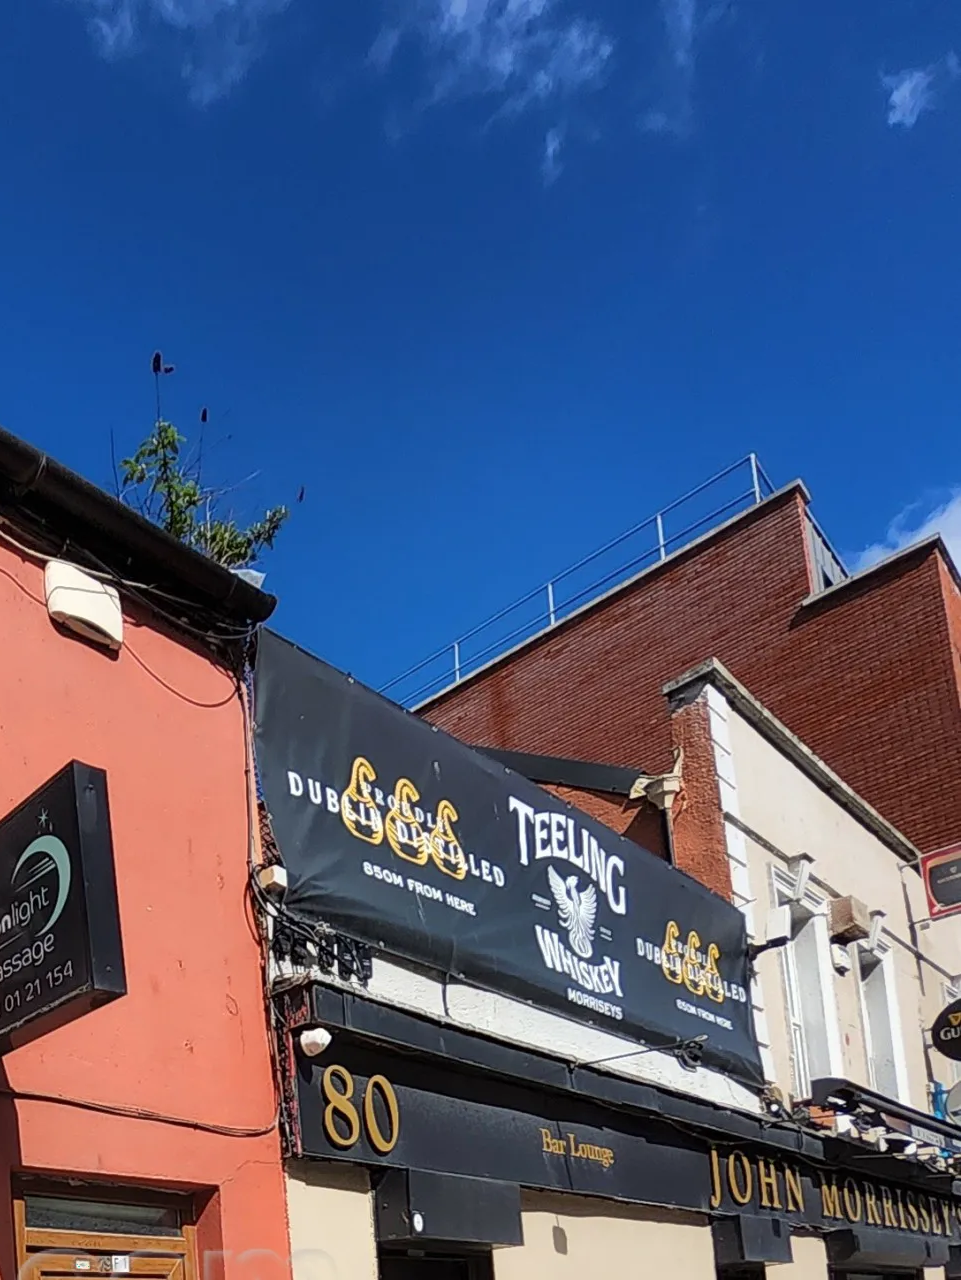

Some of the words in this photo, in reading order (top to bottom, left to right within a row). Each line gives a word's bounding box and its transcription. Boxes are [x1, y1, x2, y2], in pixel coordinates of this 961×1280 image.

[287, 771, 383, 831] DUBLIN
[509, 796, 626, 915] TEELING
[363, 861, 404, 888] 850M
[407, 878, 443, 902] FROM
[446, 893, 476, 916] HERE
[5, 989, 21, 1013] 01
[25, 975, 42, 1002] 21
[46, 960, 73, 989] 154
[535, 925, 623, 997] WHISKEY
[568, 988, 623, 1020] MORRISEYS
[322, 1064, 400, 1153] 80
[539, 1128, 566, 1155] Bar
[567, 1133, 615, 1167] Lounge
[710, 1149, 805, 1213] JOHN
[817, 1170, 961, 1237] MORRISSEY'
